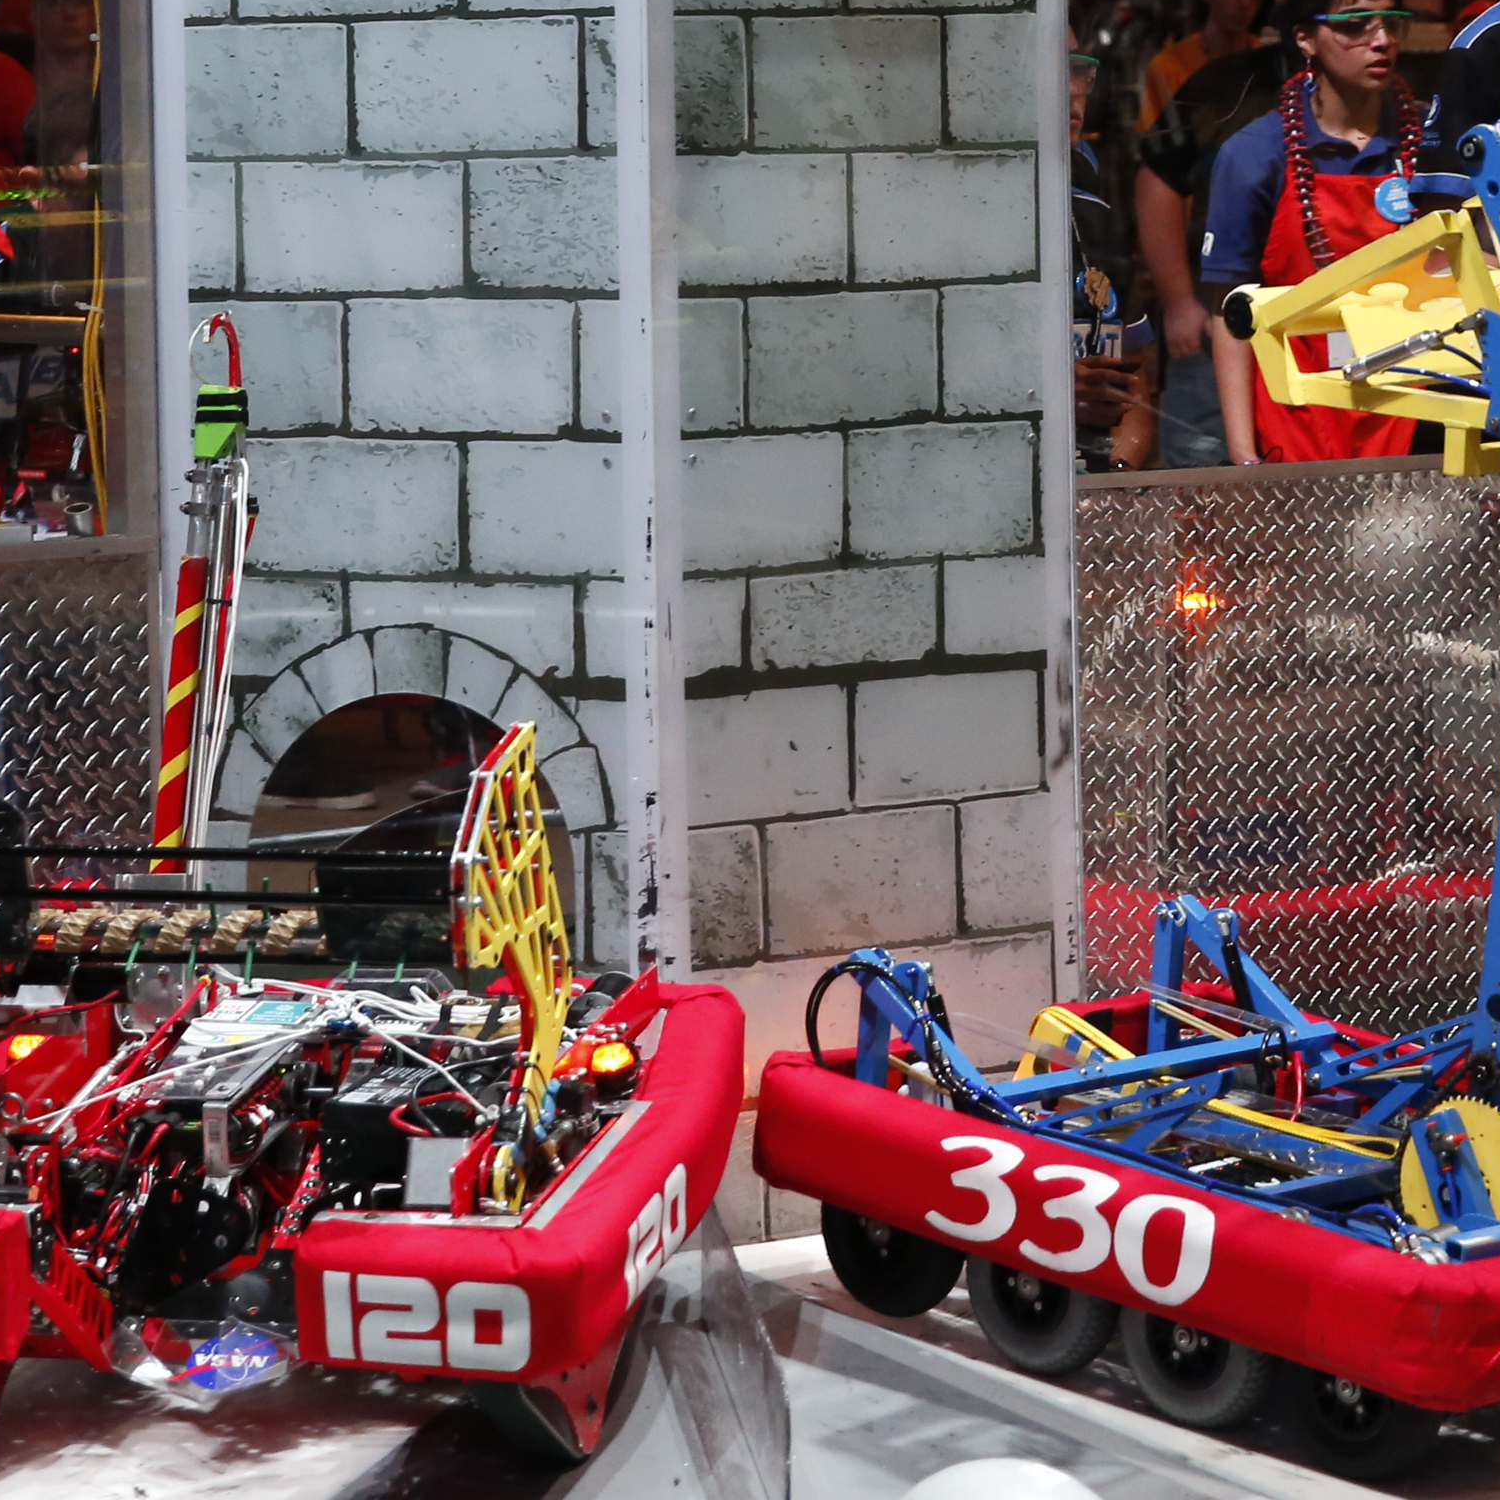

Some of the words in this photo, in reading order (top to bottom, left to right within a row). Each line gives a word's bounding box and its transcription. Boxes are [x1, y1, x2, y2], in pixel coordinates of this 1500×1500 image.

[624, 1163, 688, 1310] 120
[924, 1134, 1216, 1307] 330
[194, 1352, 270, 1369] NASA
[321, 1269, 532, 1374] 120
